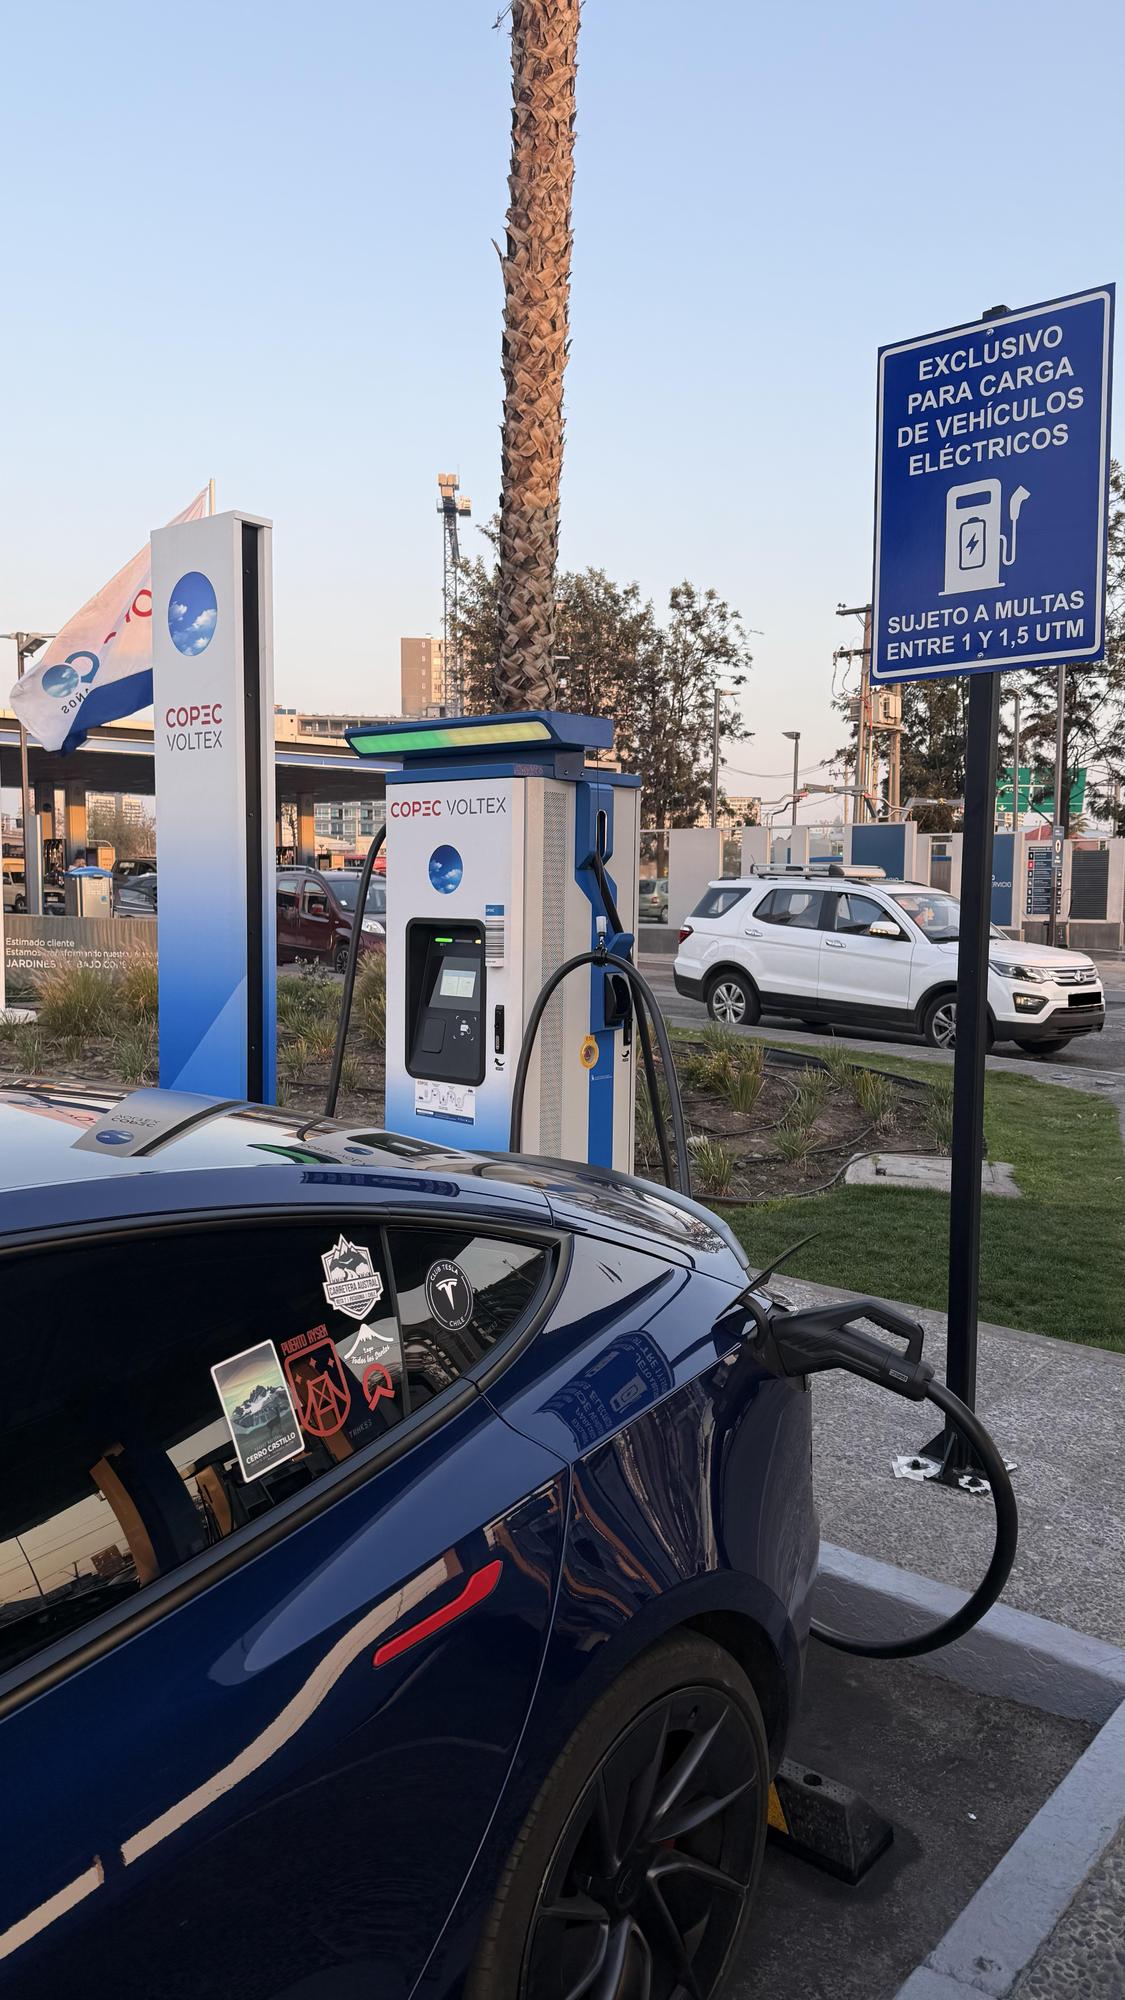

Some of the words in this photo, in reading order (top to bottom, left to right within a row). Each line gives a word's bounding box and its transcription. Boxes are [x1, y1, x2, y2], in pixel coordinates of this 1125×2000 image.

[919, 325, 1063, 381] EXCLUSIVO
[908, 381, 973, 415] PARA
[979, 356, 1074, 397] CARGA
[898, 422, 929, 448] DE
[936, 386, 1084, 439] VEHÍCULOS
[909, 423, 1069, 476] ELÉCTRICOS
[888, 607, 968, 634] SUJETO
[973, 604, 989, 623] A
[995, 590, 1084, 620] MULTAS
[887, 635, 954, 661] ENTRE
[962, 633, 970, 651] 1
[978, 630, 993, 649] Y
[1000, 626, 1028, 649] 1,5
[1036, 618, 1084, 642] UTM
[166, 703, 223, 728] COPEC
[166, 730, 223, 751] VOLTEX
[390, 799, 442, 818] COPEC
[446, 796, 506, 815] VOLTEX
[6, 937, 46, 947] Estimado
[47, 938, 75, 948] cliente
[6, 959, 57, 969] JARDINES
[430, 1266, 442, 1281] CLUB
[441, 1264, 459, 1275] TESLA
[329, 1281, 357, 1296] CARRETERA
[357, 1277, 378, 1290] AUSTRAL
[449, 1316, 465, 1327] CHILE
[280, 1333, 308, 1357] PUERTO
[246, 1447, 268, 1464] CERRO
[267, 1432, 296, 1452] CASTILLO
